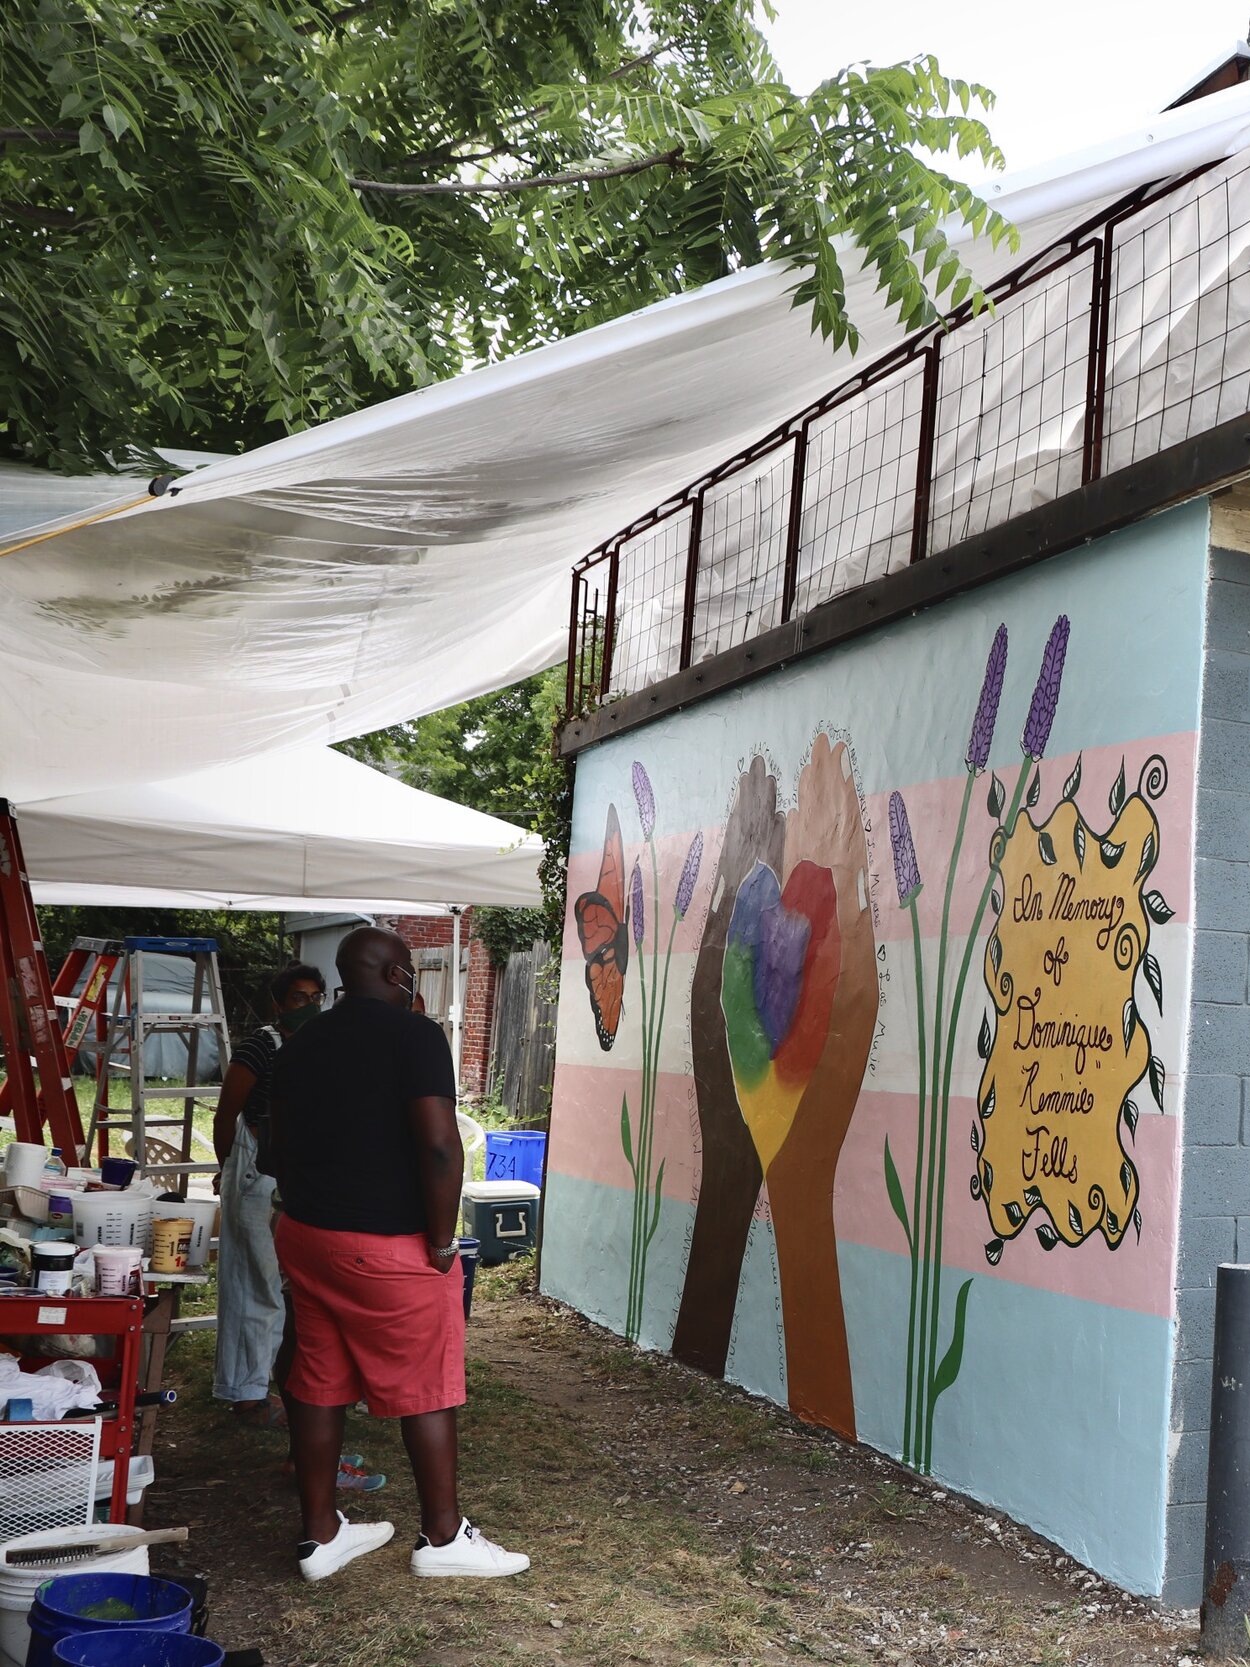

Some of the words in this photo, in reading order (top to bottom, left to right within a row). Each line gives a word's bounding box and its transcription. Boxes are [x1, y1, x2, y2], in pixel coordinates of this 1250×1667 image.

[1013, 873, 1043, 923] In
[1048, 872, 1125, 951] Memory
[1043, 936, 1069, 986] of
[1013, 987, 1113, 1075] Dominique
[486, 1151, 516, 1181] 734
[1022, 1125, 1078, 1184] Fells
[667, 1285, 684, 1340] BLACK
[679, 1222, 694, 1276] TRANS
[687, 1082, 703, 1155] MATTER
